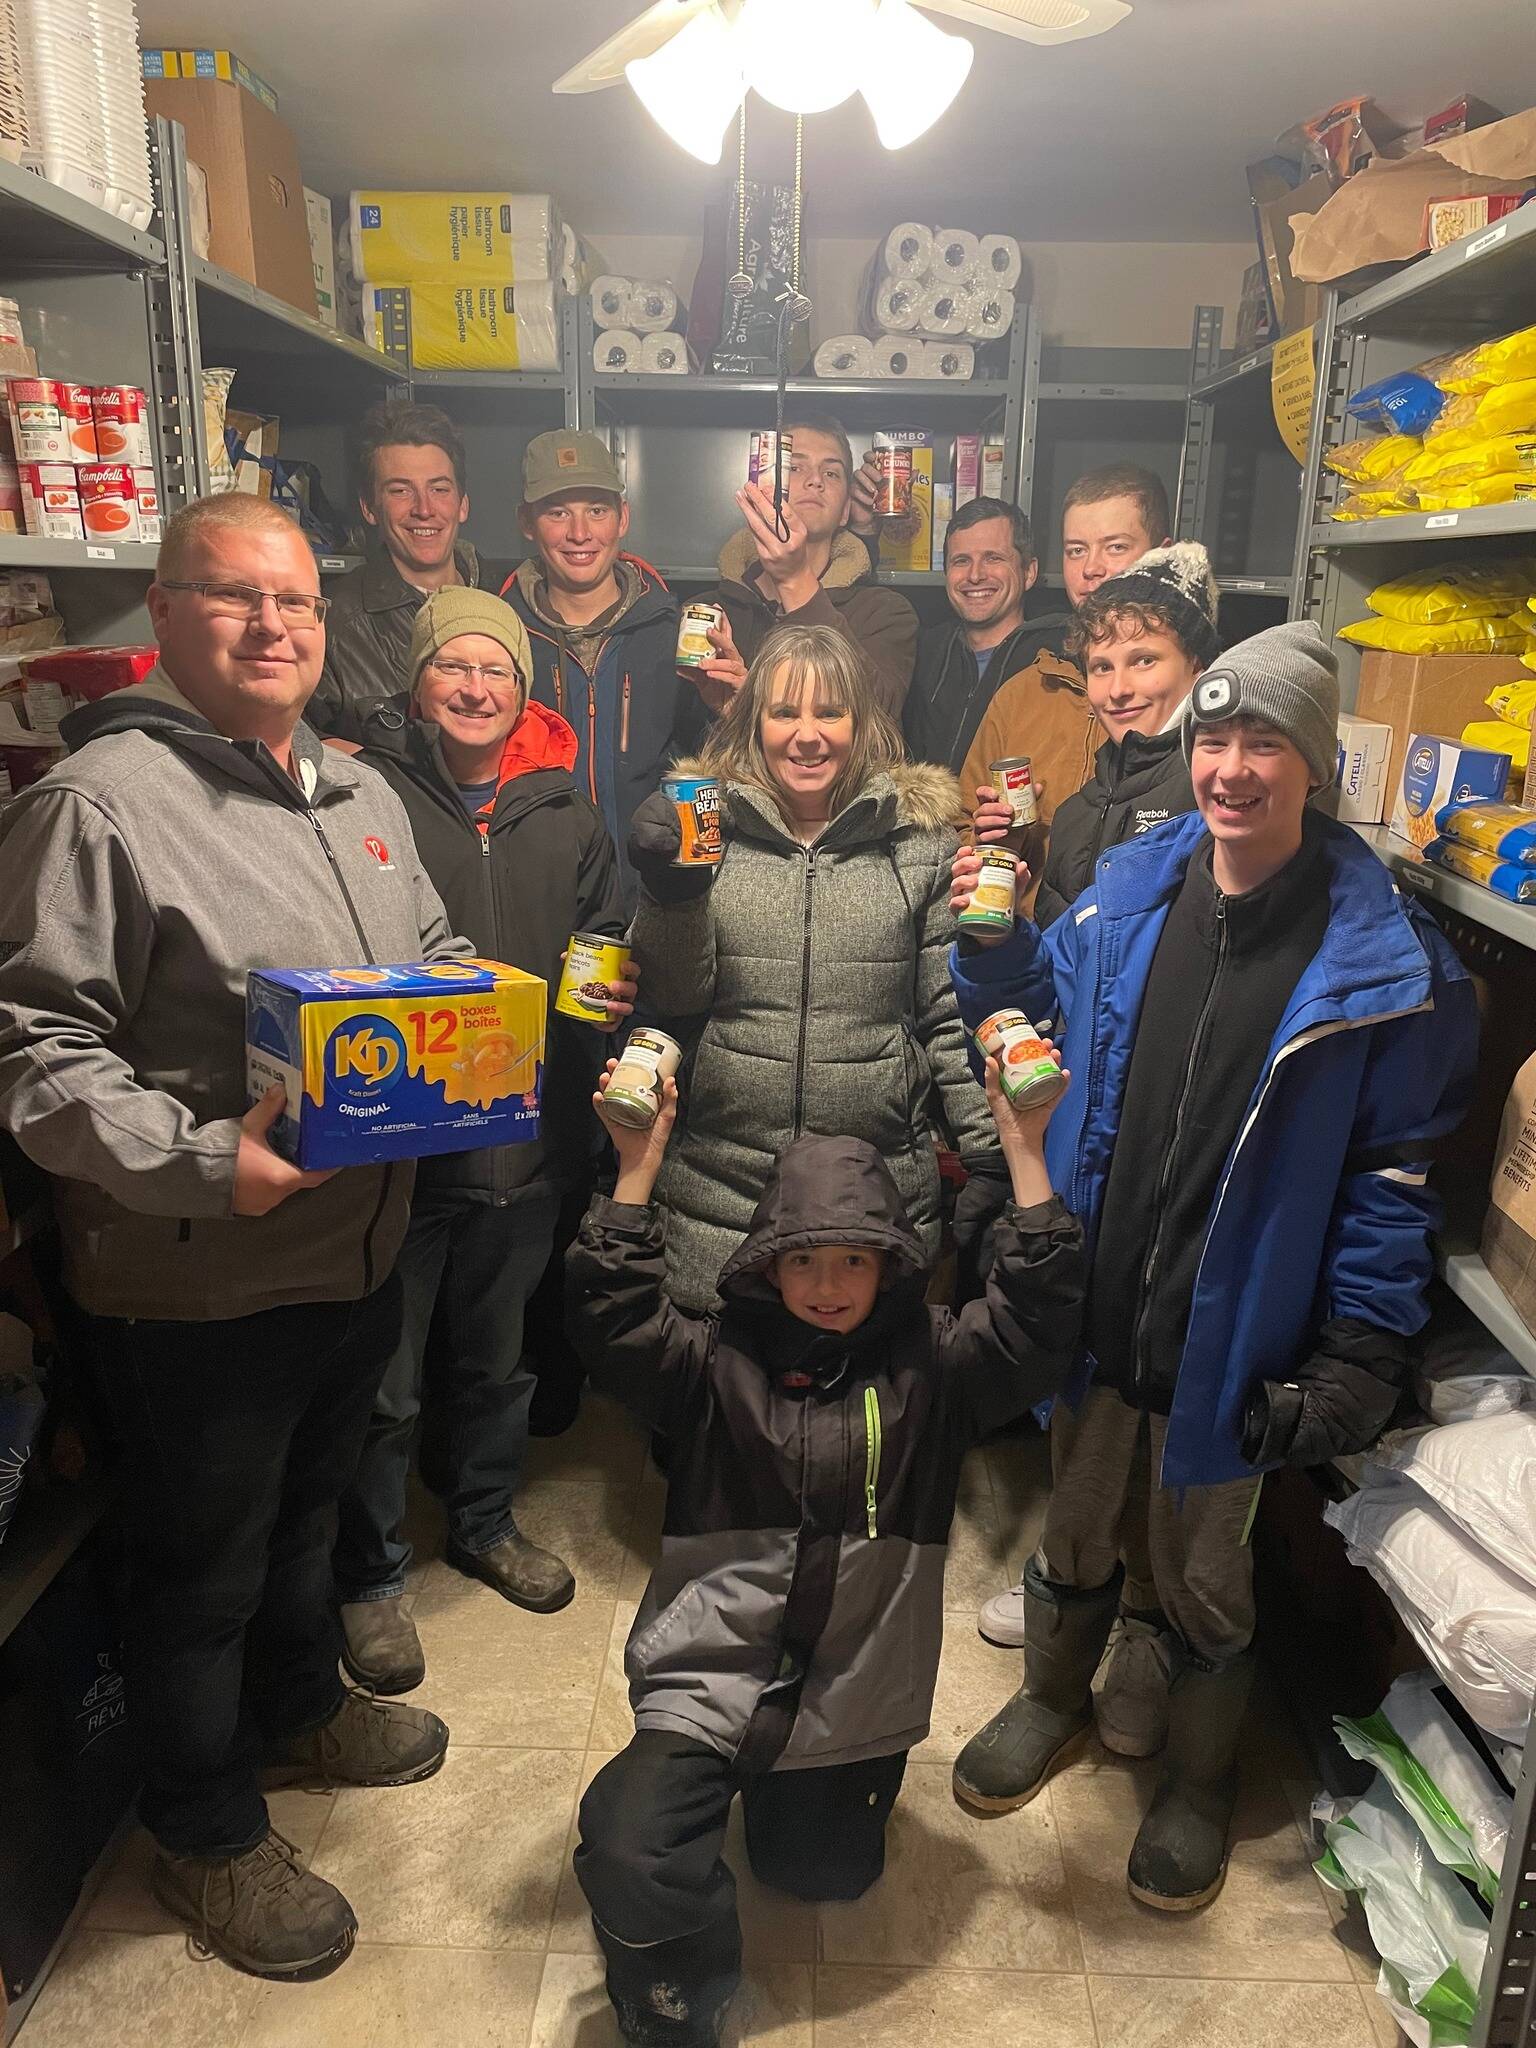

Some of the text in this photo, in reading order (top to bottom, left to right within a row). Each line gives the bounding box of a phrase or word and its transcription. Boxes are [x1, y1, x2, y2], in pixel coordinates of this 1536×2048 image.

[368, 208, 379, 225] 24
[459, 206, 468, 239] papier
[474, 206, 483, 237] tissue
[451, 205, 460, 262] hygiénique
[484, 206, 492, 257] bathroom
[456, 288, 466, 343] hygiénique
[466, 288, 474, 321] papier
[479, 288, 487, 319] tissue
[488, 288, 497, 338] bathroom
[78, 467, 124, 484] Campbell's
[1347, 753, 1362, 796] CATELLI
[696, 800, 719, 815] BEA
[1136, 809, 1169, 820] Reebok
[1000, 860, 1013, 869] GOLD
[460, 1005, 497, 1018] boxes
[464, 1014, 501, 1029] boîtes
[407, 1008, 458, 1055] 12
[335, 1027, 400, 1085] KD
[338, 1102, 391, 1117] ORIGINAL
[383, 1122, 417, 1131] ARTIFICIAL
[452, 1119, 489, 1129] ARTIFICIELS
[1512, 1146, 1536, 1170] LIFETIM
[1503, 1166, 1532, 1192] BENEFITS
